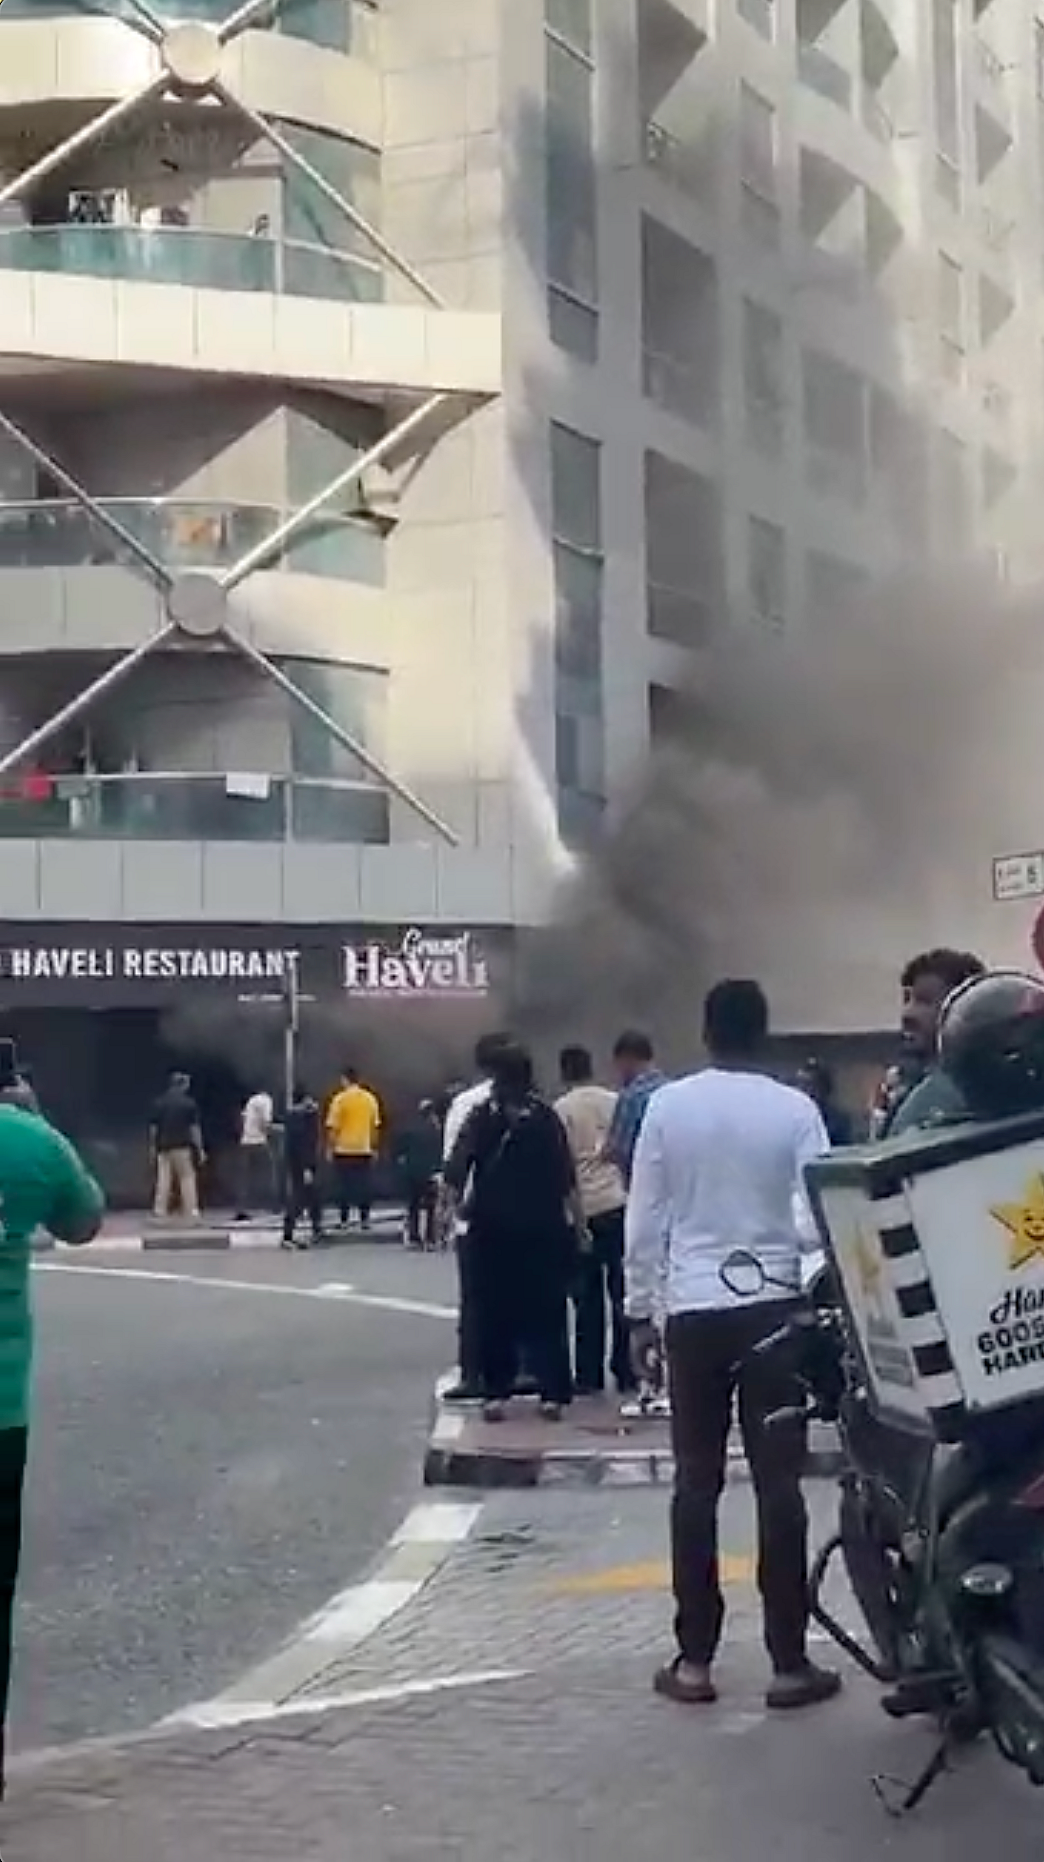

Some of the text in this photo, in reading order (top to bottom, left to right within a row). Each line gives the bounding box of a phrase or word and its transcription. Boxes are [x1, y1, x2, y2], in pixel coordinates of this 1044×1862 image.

[12, 948, 113, 977] HAVELI
[123, 949, 300, 977] RESTAURANT
[343, 945, 489, 988] Haveli
